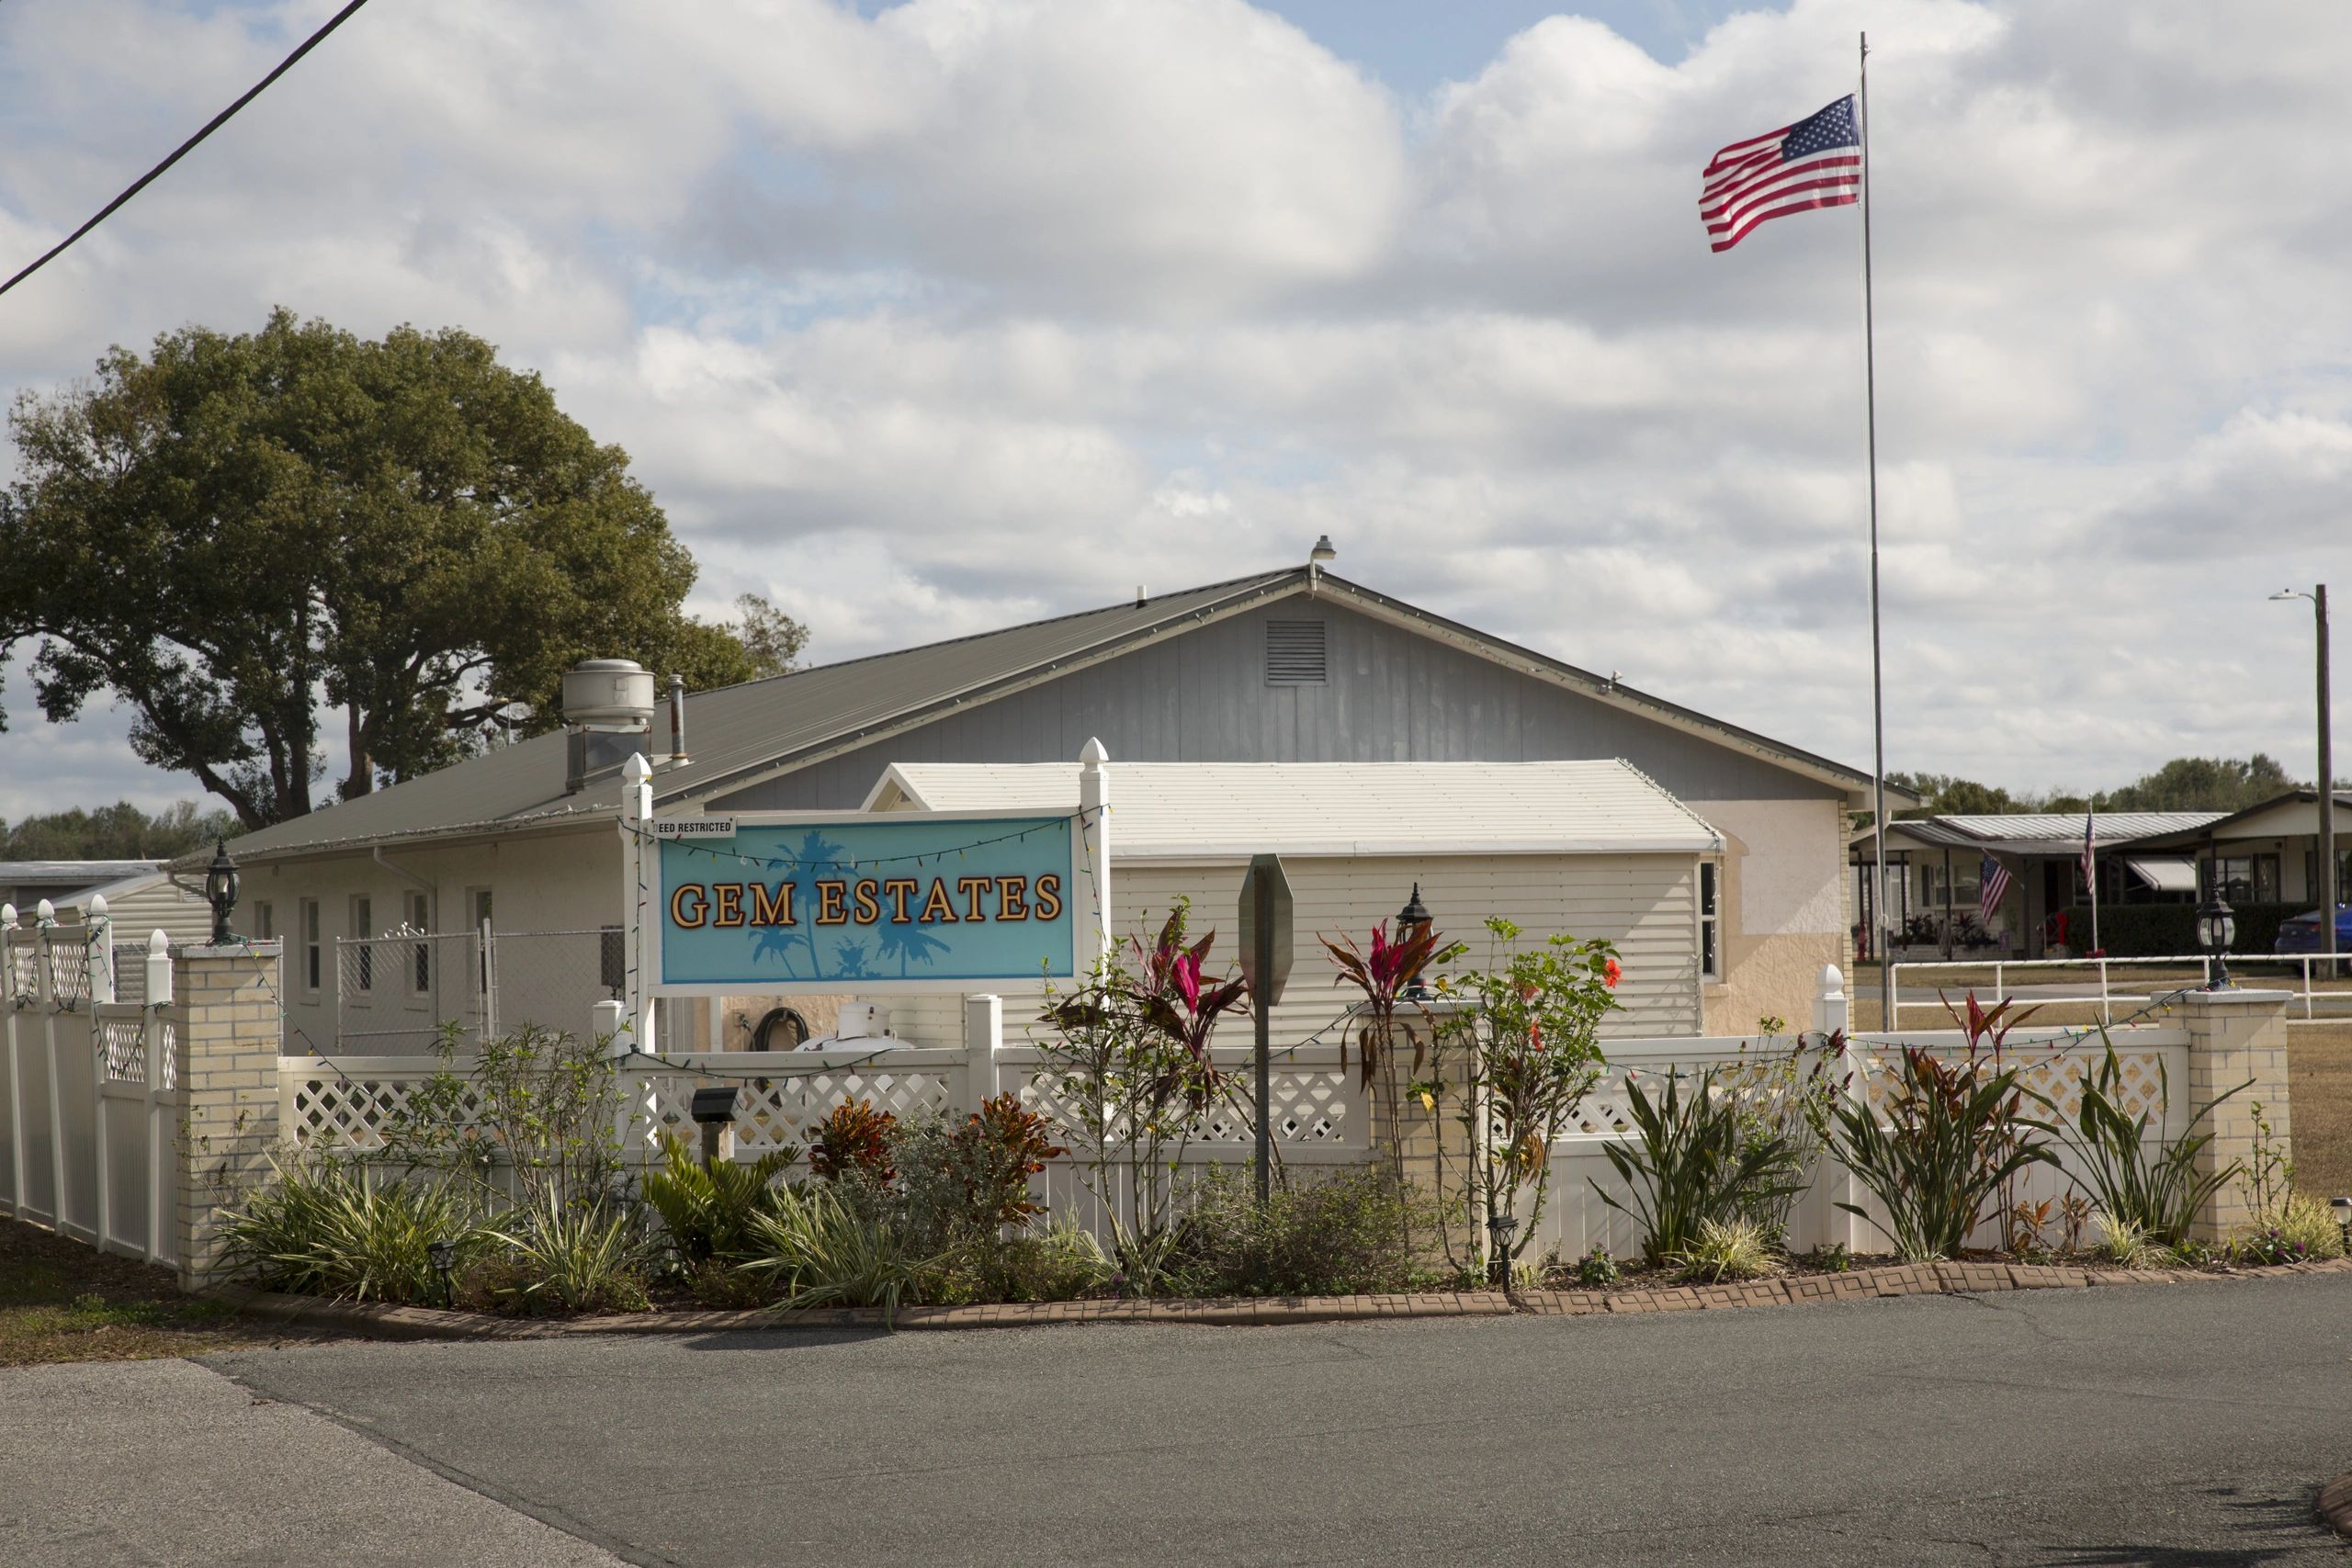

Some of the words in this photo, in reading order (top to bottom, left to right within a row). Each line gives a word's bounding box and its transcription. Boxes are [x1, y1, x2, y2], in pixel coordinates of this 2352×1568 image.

[678, 822, 731, 832] RESTRICTED
[671, 882, 797, 929] GEM
[816, 874, 1062, 925] ESTATES
